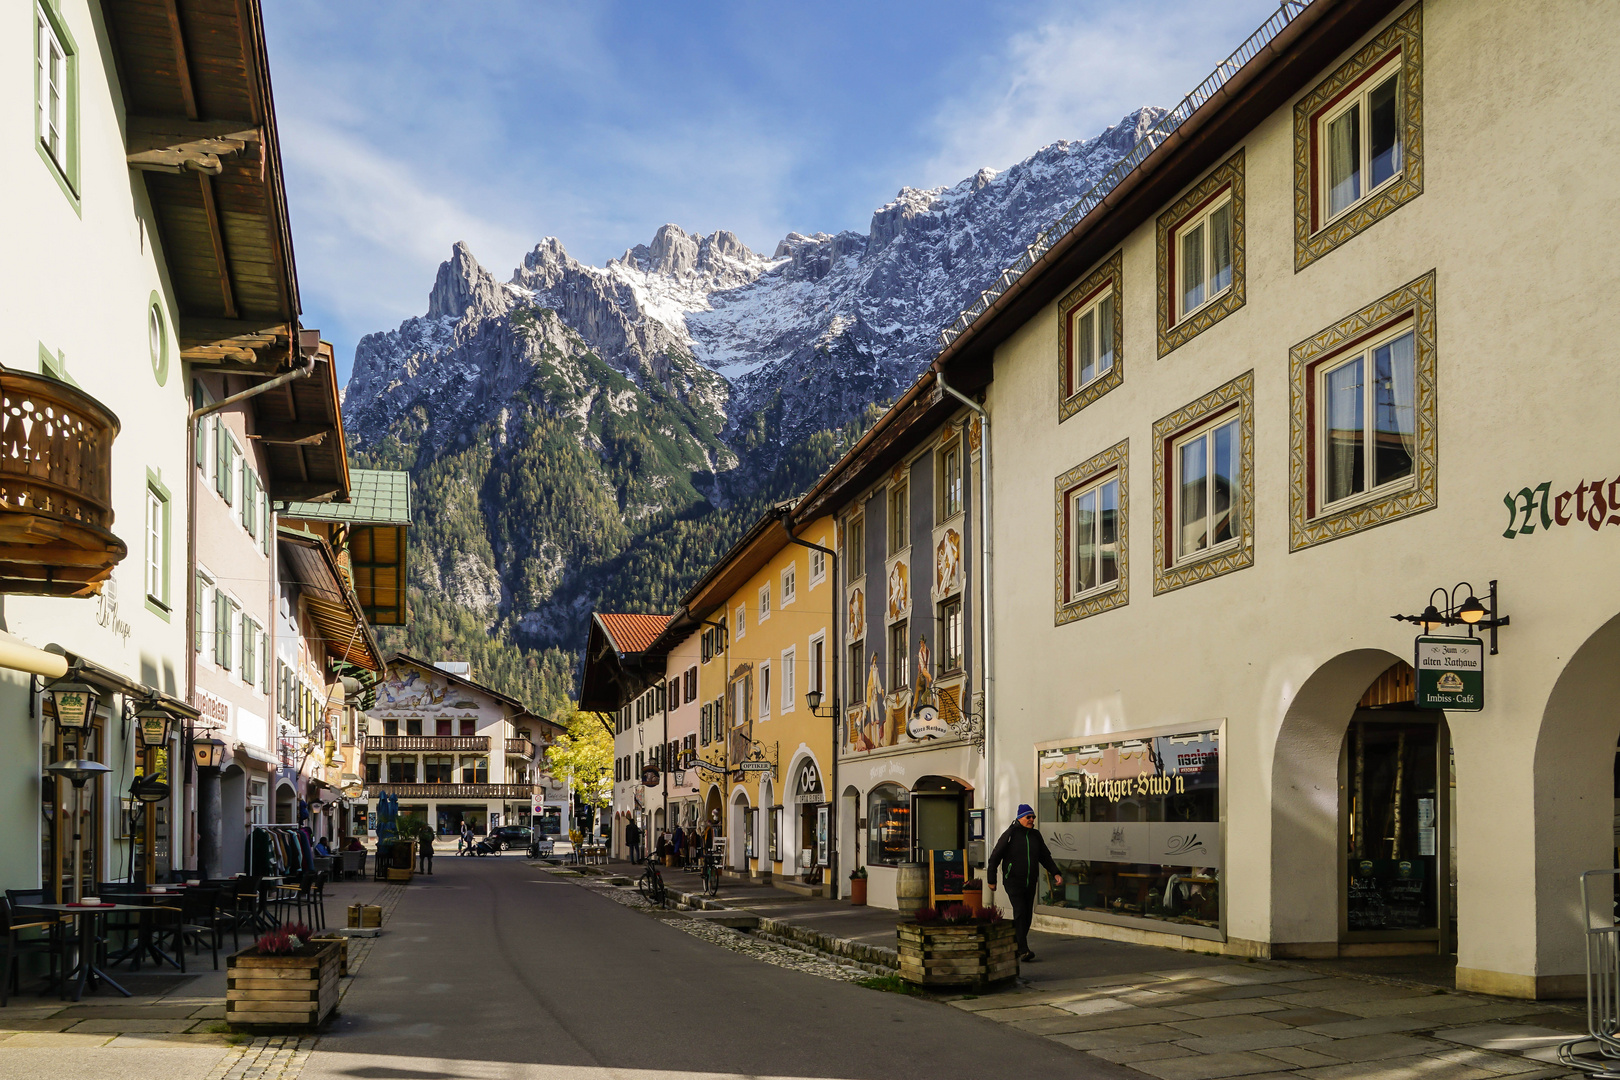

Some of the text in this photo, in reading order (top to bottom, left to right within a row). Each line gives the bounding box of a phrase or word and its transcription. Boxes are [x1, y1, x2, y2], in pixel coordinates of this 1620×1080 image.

[1442, 645, 1457, 655] Zum
[1422, 657, 1477, 668] alten Rathaus
[1427, 693, 1474, 703] Imbiss Café
[801, 765, 816, 792] oe
[1061, 767, 1185, 803] Zur Metzger-Stub'n
